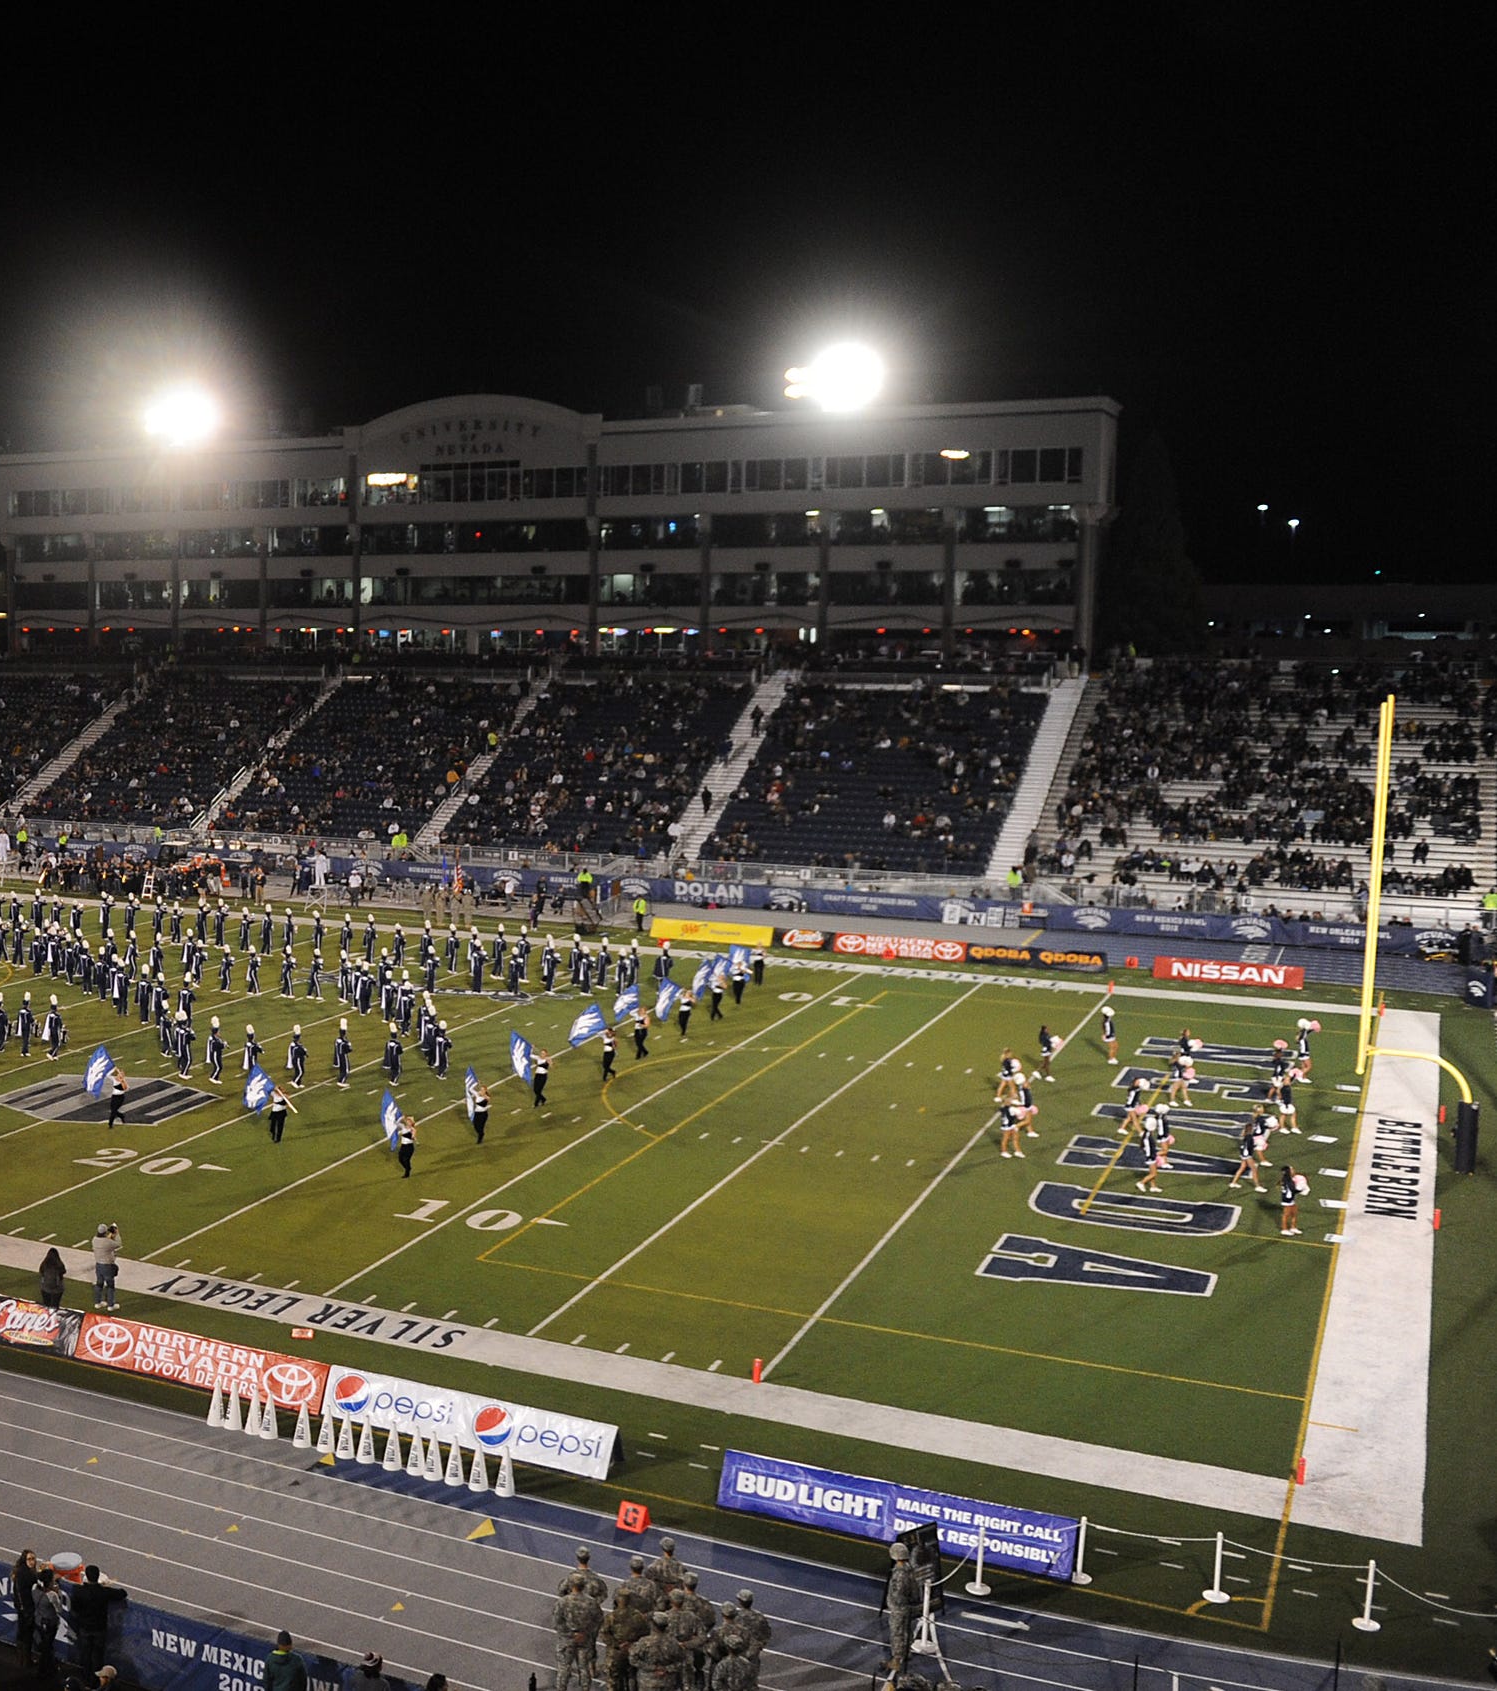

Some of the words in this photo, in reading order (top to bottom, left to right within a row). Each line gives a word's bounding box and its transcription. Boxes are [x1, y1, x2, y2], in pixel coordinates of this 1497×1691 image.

[436, 443, 503, 456] NEVADA
[674, 880, 743, 899] DOLAN
[1073, 907, 1111, 921] NEVADA
[1134, 914, 1153, 922] NEW
[1154, 915, 1183, 924] MEXICO
[1184, 917, 1207, 927] BOWL
[1231, 917, 1271, 931] NEVADA
[865, 935, 935, 947] NORTHERN
[1309, 926, 1328, 934] NEW
[1415, 930, 1456, 942] NEVADA
[864, 941, 934, 953] NEVADA
[969, 946, 1031, 960] QDOBA
[1038, 950, 1103, 966] QDOBA
[1171, 961, 1285, 985] NISSAN
[1371, 1119, 1422, 1174] BATTLE
[72, 1148, 193, 1175] 20
[1364, 1174, 1420, 1221] BORN
[393, 1198, 523, 1231] 10
[149, 1274, 303, 1316] LEGACY
[310, 1302, 467, 1349] SILVER
[135, 1340, 259, 1381] NEVADA
[137, 1327, 264, 1368] NORTHERN
[133, 1355, 190, 1380] TOYOTA
[374, 1390, 454, 1427] pepsi
[516, 1424, 602, 1465] pepsi
[736, 1470, 796, 1502] BUD
[798, 1483, 883, 1520] LIGHT
[624, 1507, 639, 1528] G
[895, 1497, 942, 1518] MAKE
[943, 1507, 973, 1525] THE
[973, 1512, 1022, 1535] RIGHT
[1023, 1523, 1063, 1543] CALL
[947, 1529, 1061, 1565] RESPONSIBLY
[151, 1628, 197, 1659] NEW
[201, 1642, 266, 1680] MEXIC
